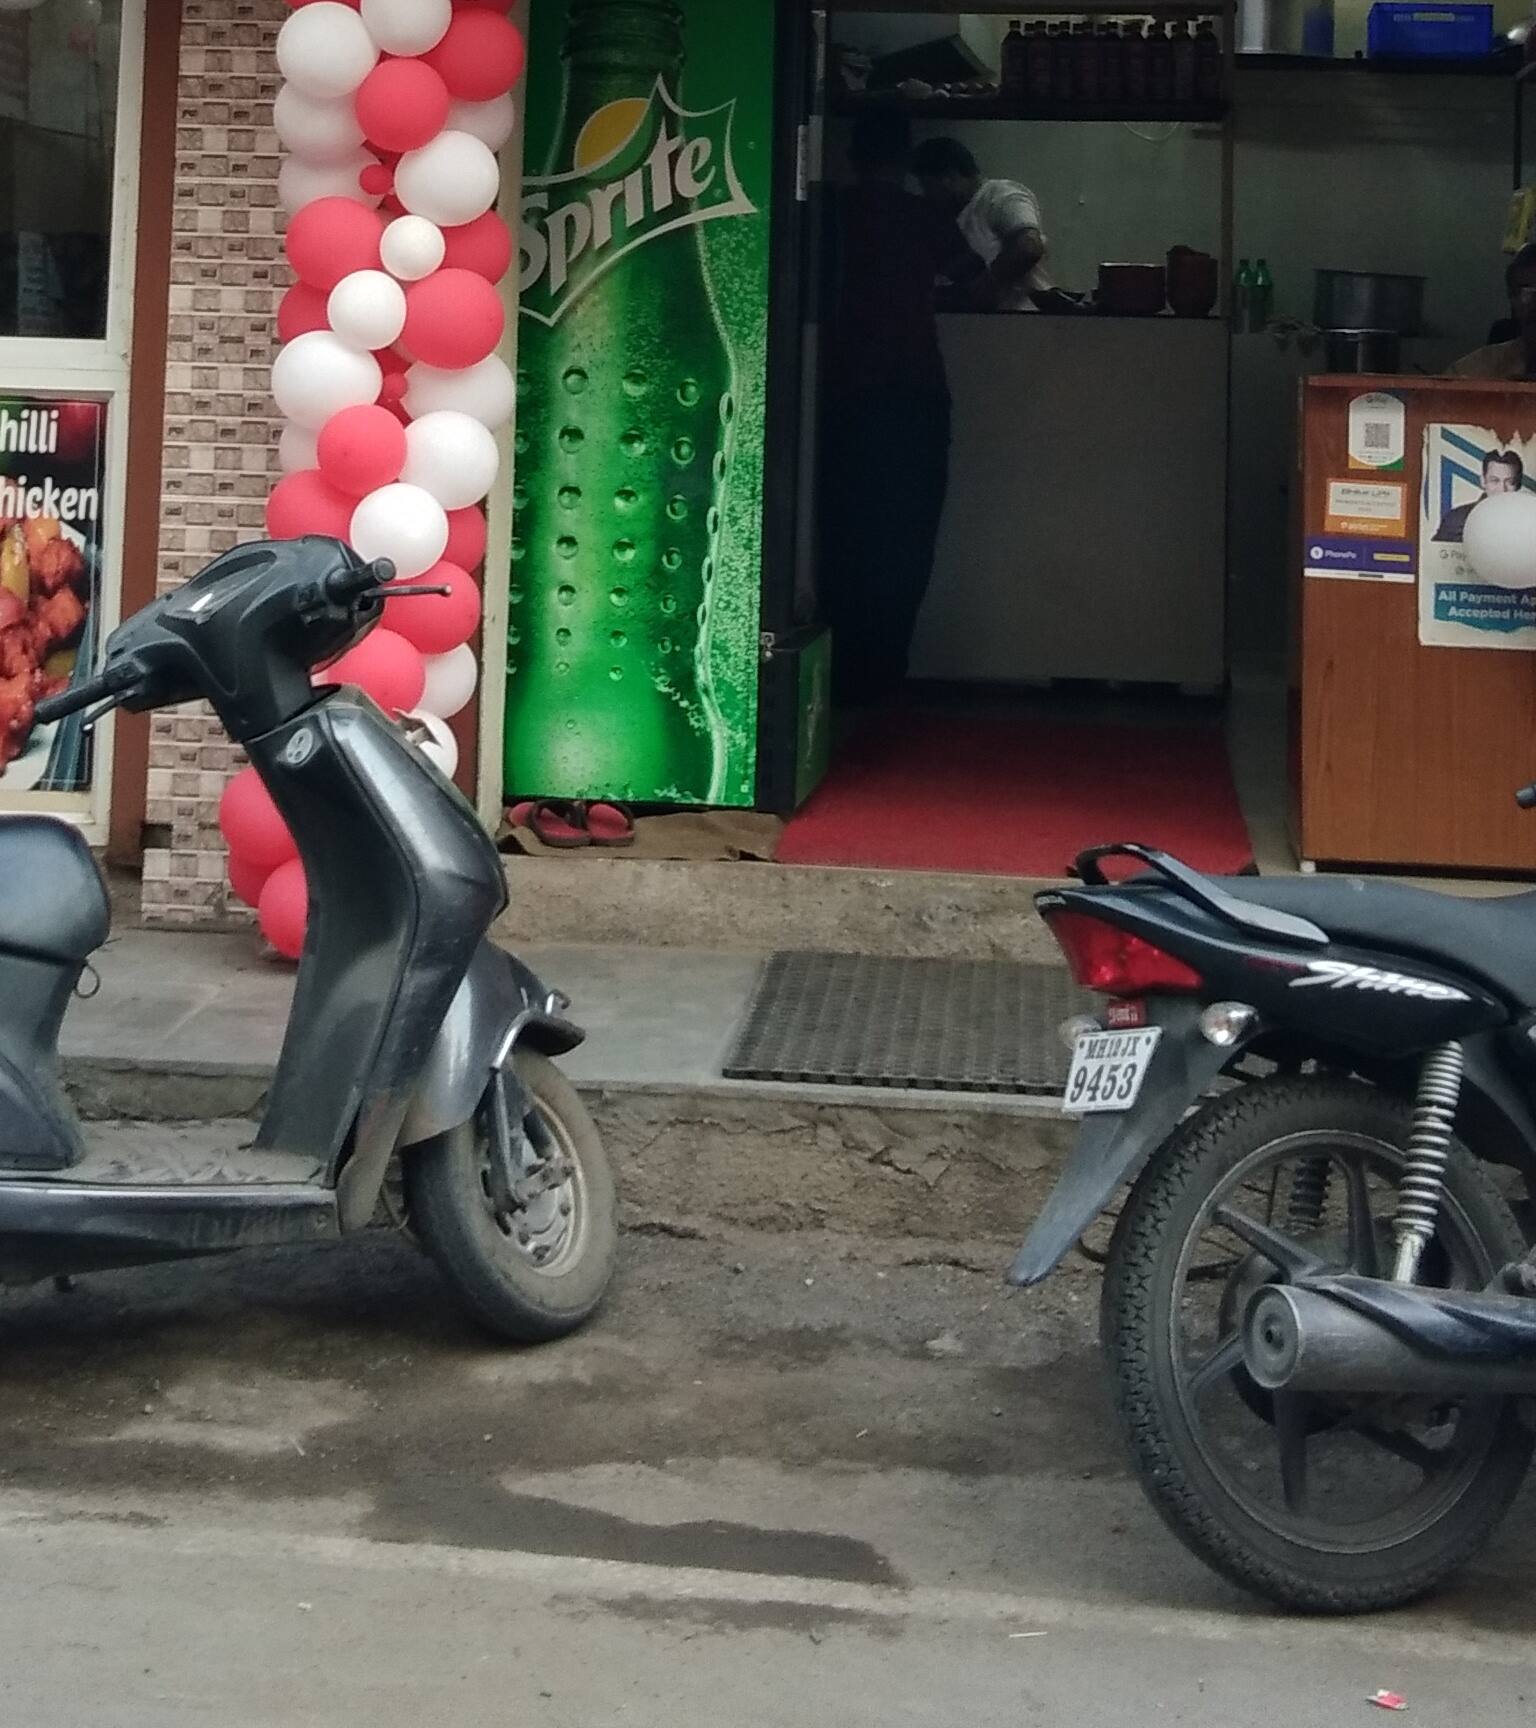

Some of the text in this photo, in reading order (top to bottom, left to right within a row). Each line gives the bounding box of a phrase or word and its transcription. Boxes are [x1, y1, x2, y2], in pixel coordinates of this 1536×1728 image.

[1438, 590, 1457, 602] All
[1459, 591, 1518, 605] Payment
[1447, 605, 1511, 620] Accepted
[1069, 1062, 1138, 1104] 9453
